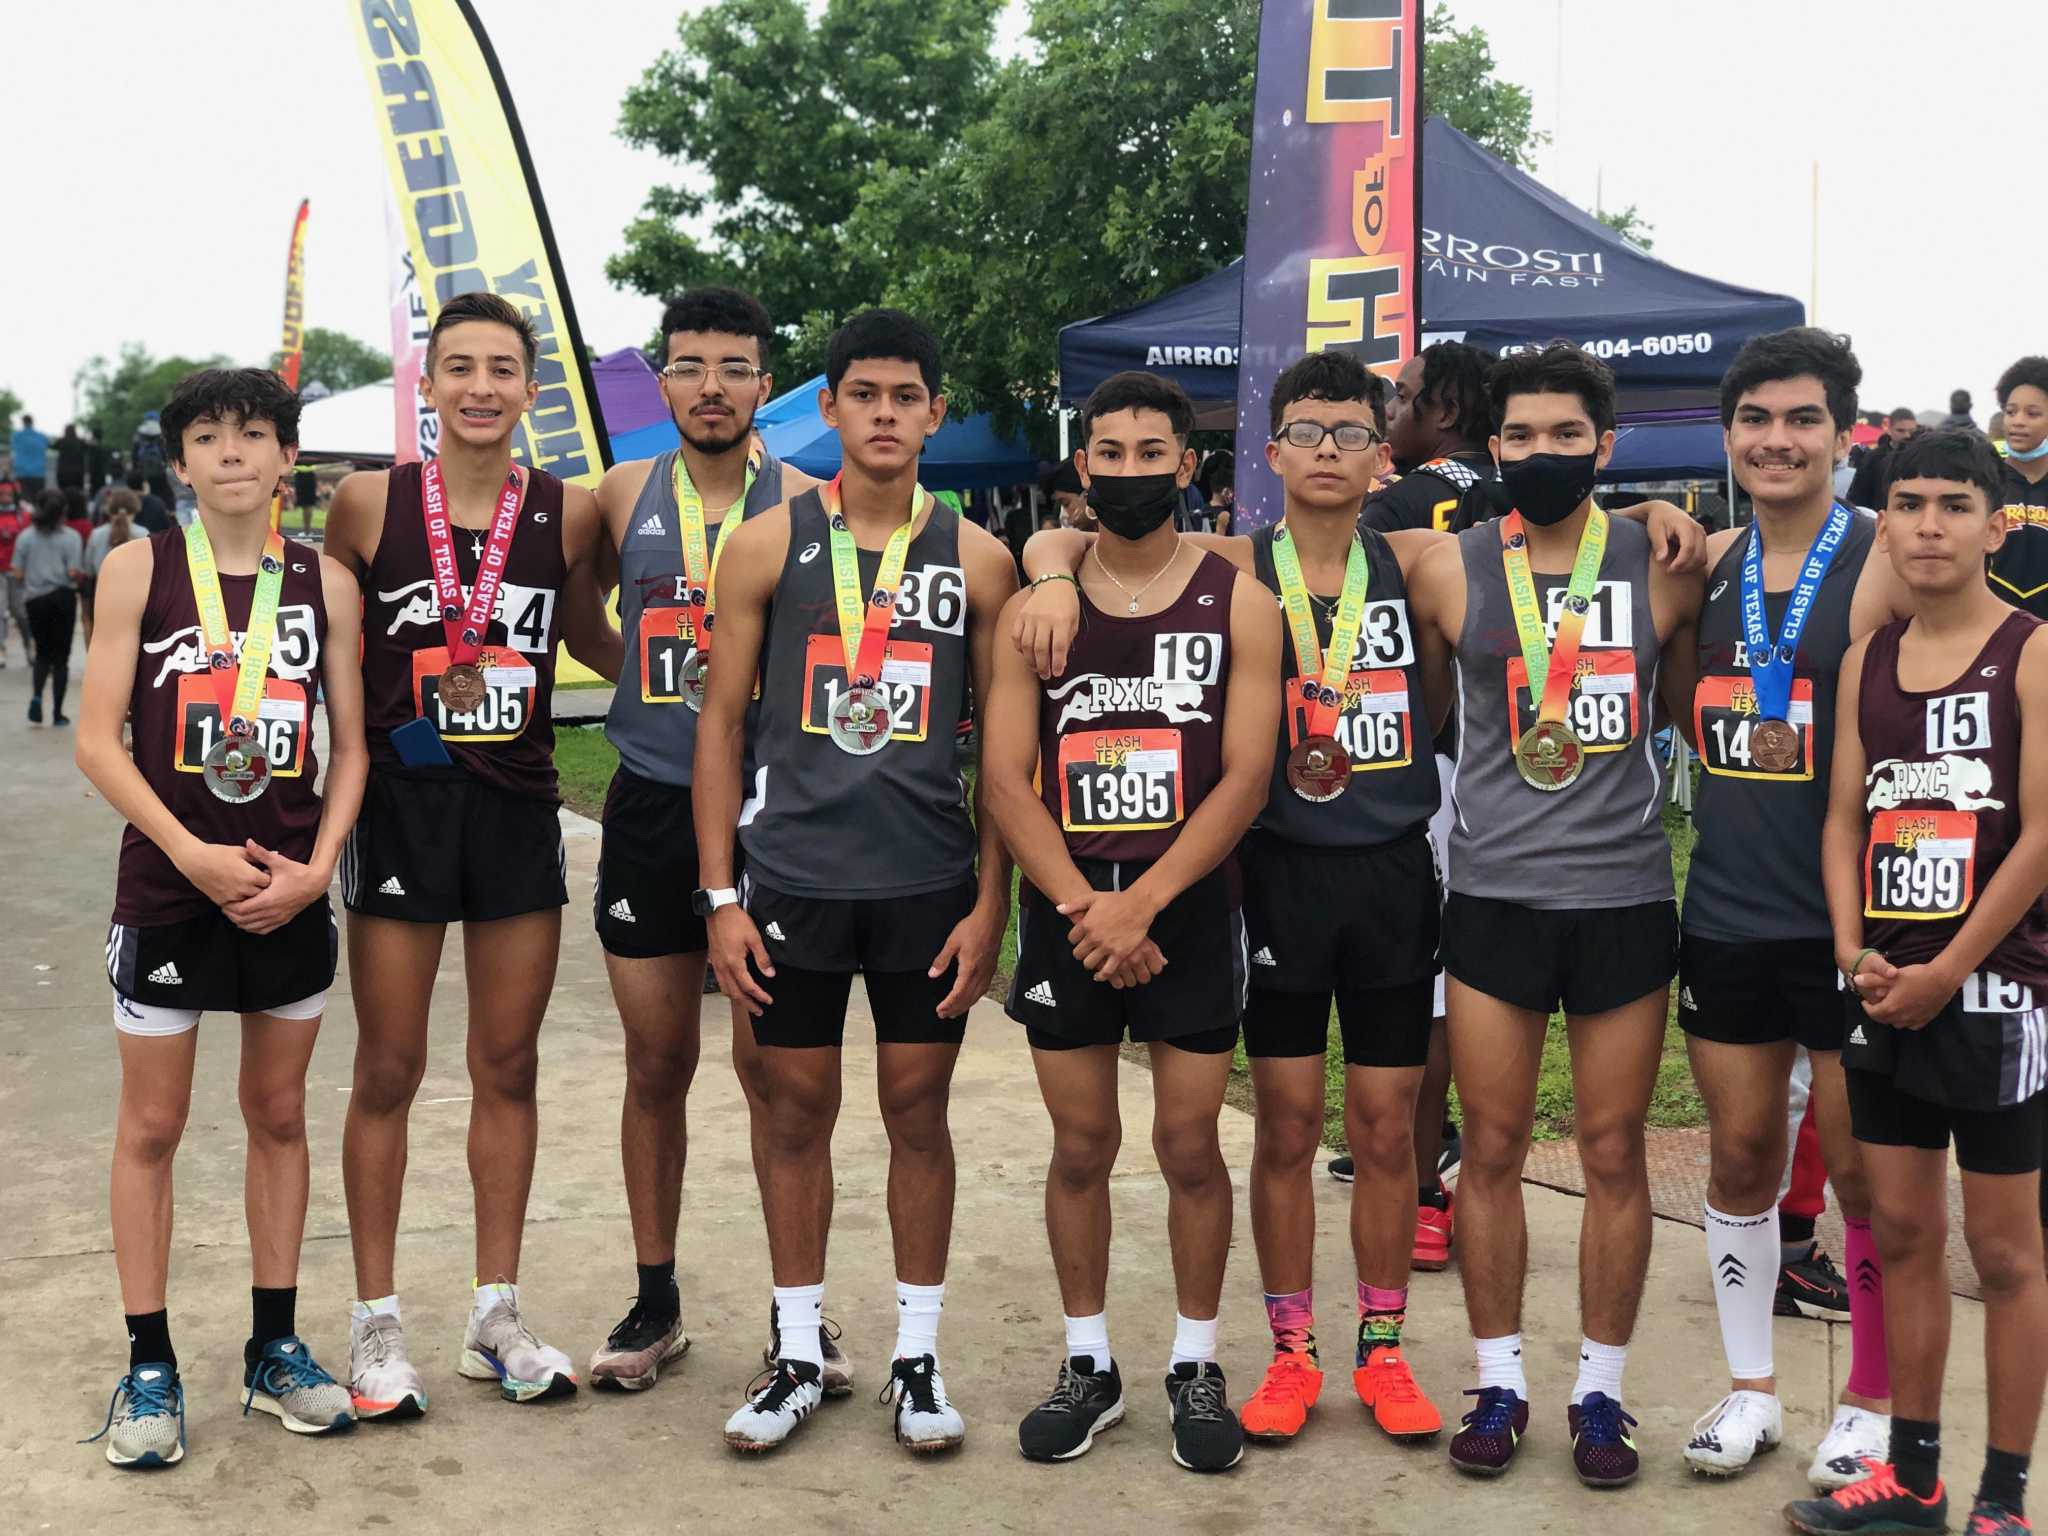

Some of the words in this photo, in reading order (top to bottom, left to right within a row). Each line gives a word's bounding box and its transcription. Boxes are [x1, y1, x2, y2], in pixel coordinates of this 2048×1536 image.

[1427, 258, 1488, 282] AIN
[1511, 274, 1604, 288] FAST
[425, 465, 443, 514] CLASH
[430, 519, 447, 539] OF
[494, 491, 518, 540] TEXAS
[638, 526, 666, 536] adidas
[434, 544, 458, 598] TEXAS
[487, 544, 504, 566] OF
[688, 529, 705, 582] TEXAS
[1744, 564, 1758, 583] OF
[1784, 584, 1814, 639] CLASH
[1805, 557, 1823, 579] OF
[1816, 509, 1848, 553] TEXAS
[471, 570, 498, 624] CLASH
[895, 571, 964, 628] 36
[1289, 593, 1306, 613] OF
[1507, 555, 1532, 608] CLASH
[1521, 613, 1538, 634] OF
[1746, 589, 1764, 645] TEXAS
[277, 610, 309, 666] 5
[514, 593, 545, 648] 4
[1327, 628, 1353, 682] CLASH
[1341, 602, 1357, 623] OF
[1160, 635, 1213, 682] 19
[238, 656, 262, 711] CLASH
[1089, 676, 1163, 713] RXC
[1095, 736, 1141, 748] CLASH
[1931, 697, 1977, 748] 15
[1078, 771, 1169, 821] 1395
[1889, 762, 1950, 801] RXC
[1897, 817, 1936, 830] CLASH
[1878, 856, 1959, 909] 1399
[148, 972, 183, 985] adidas
